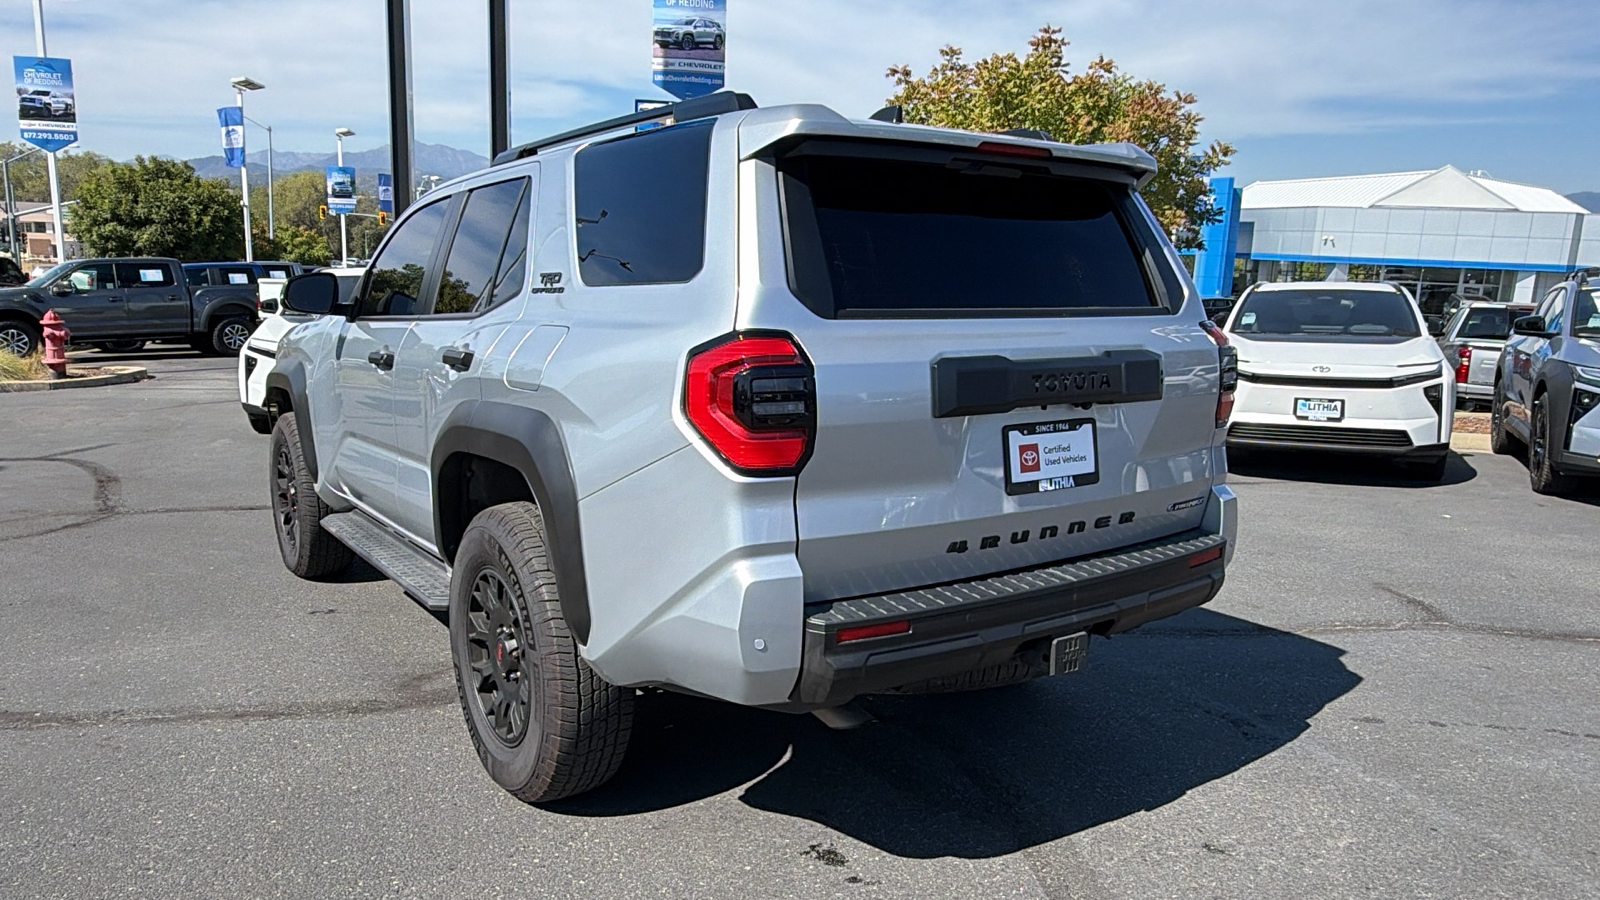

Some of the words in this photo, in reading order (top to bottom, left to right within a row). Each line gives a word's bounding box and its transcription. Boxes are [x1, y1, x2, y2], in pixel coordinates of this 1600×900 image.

[678, 0, 714, 9] REDDING
[678, 61, 723, 70] CHEVROLET
[23, 71, 62, 79] CHEVROLET
[33, 78, 63, 86] REDDING
[23, 131, 75, 140] 877.293.5503
[540, 272, 562, 287] TRD
[1032, 371, 1111, 393] TOYOTA
[1307, 403, 1339, 411] LITHIA
[1035, 425, 1054, 433] SINCE
[1055, 423, 1070, 431] 1946
[1043, 444, 1071, 454] Certified
[1044, 457, 1060, 466] Used
[1063, 454, 1087, 464] Vehicles
[946, 511, 1136, 554] 4RUNNER
